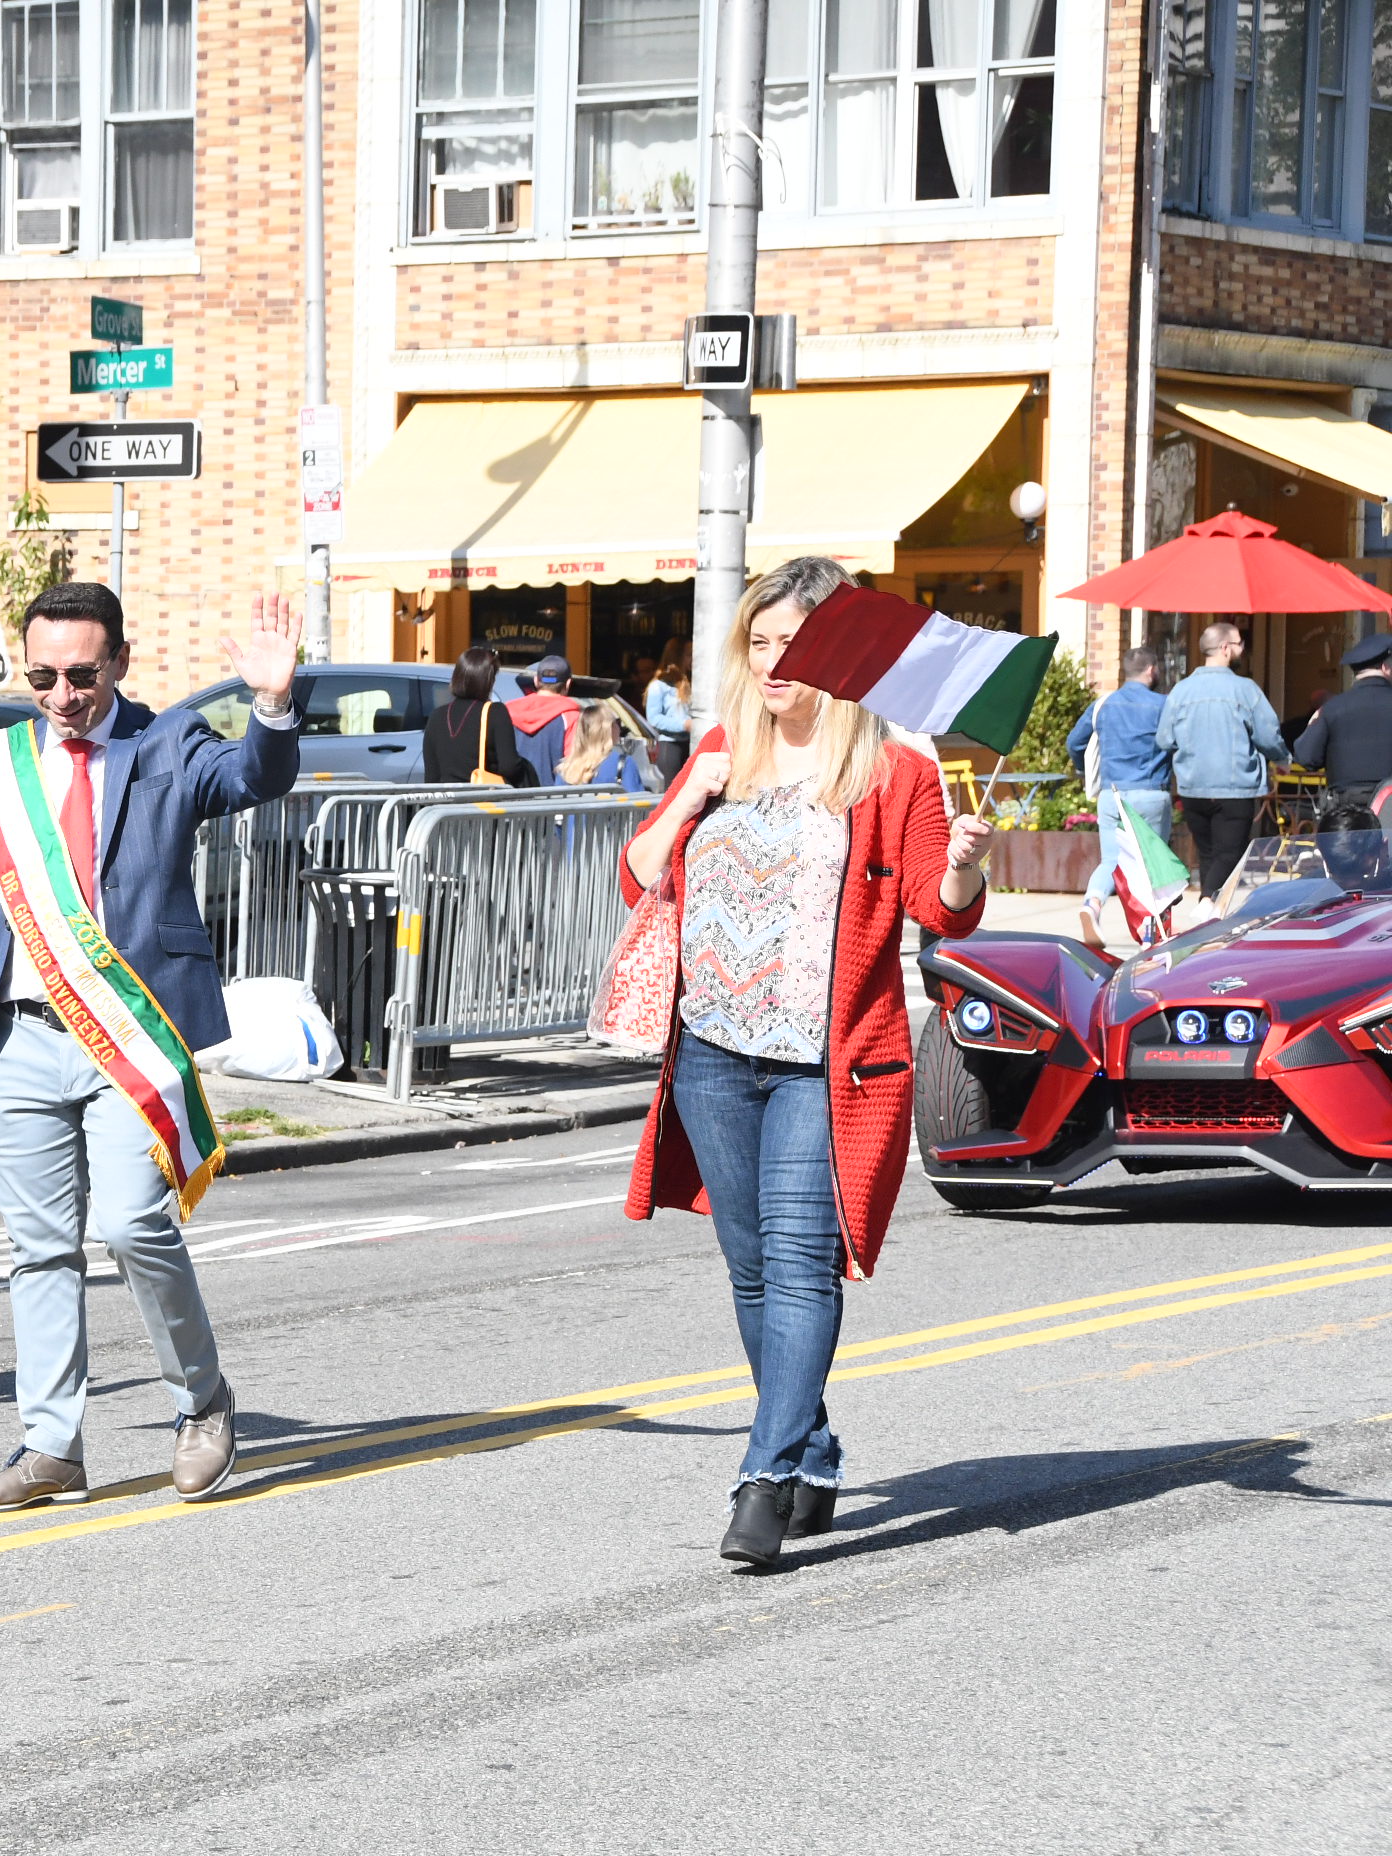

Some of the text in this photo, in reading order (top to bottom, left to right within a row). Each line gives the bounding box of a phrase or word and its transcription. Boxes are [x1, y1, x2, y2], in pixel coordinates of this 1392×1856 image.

[95, 303, 129, 338] Grove
[699, 336, 731, 362] WAY
[77, 353, 166, 386] Mercer St
[69, 438, 172, 463] ONE WAY
[427, 566, 498, 579] BRUNCH
[546, 561, 606, 574] LUNCH
[655, 558, 697, 570] DINN
[485, 624, 554, 642] SLOW FOOD
[66, 911, 113, 970] 2019
[0, 869, 20, 903] DR.
[13, 902, 53, 970] GIORGIO
[45, 970, 117, 1064] DIVINCENZO
[1143, 1049, 1232, 1062] POLARIS
